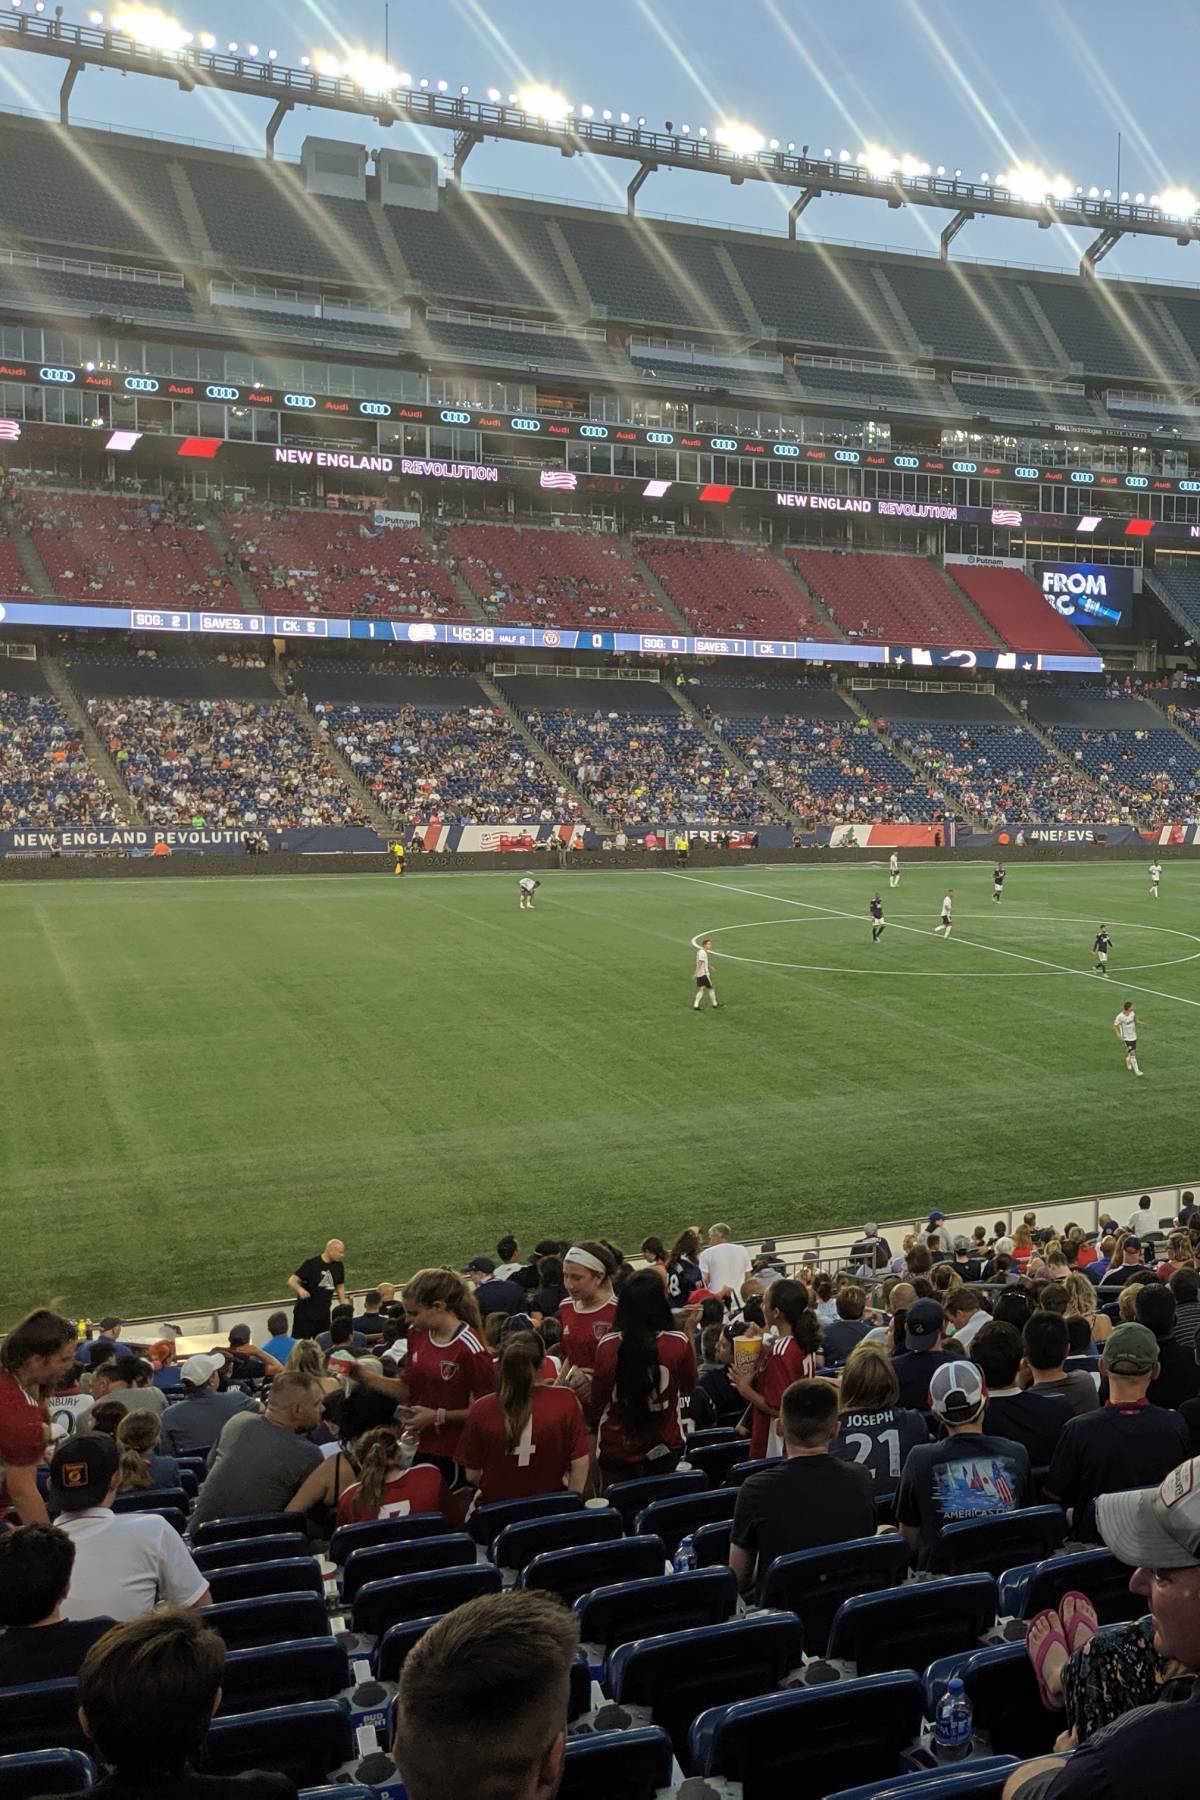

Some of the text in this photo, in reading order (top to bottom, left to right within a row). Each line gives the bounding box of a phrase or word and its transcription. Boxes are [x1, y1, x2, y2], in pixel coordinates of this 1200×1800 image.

[85, 376, 112, 386] Audi
[168, 385, 194, 395] Audi
[248, 393, 273, 403] Audi
[325, 401, 349, 411] Audi
[400, 408, 422, 419] Audi
[479, 417, 501, 427] Audi
[548, 425, 570, 434] Audi
[616, 431, 636, 440] Audi
[681, 438, 701, 447] Audi
[744, 443, 765, 453] Audi
[806, 450, 825, 459] Audi
[866, 455, 885, 464] Audi
[275, 448, 498, 481] NEW ENGLAND REVOLUTION
[926, 461, 944, 470] Audi
[983, 466, 1001, 475] Audi
[1045, 472, 1063, 480] Audi
[1100, 477, 1118, 485] Audi
[1154, 481, 1171, 489] Audi
[776, 493, 957, 520] NEW ENGLAND REVOLUTION
[976, 557, 1004, 565] Putnam
[1042, 572, 1107, 595] FROM
[137, 614, 181, 627] SOG: 2
[203, 618, 259, 630] SAVES: 0
[282, 620, 316, 633] CK: 5
[452, 628, 526, 644] 46:38 HALF 2
[592, 634, 602, 648] 0
[643, 639, 679, 649] SOG: 0
[697, 641, 729, 652] SAVES:
[760, 644, 775, 654] CK:
[13, 833, 55, 847] NEW
[62, 832, 147, 846] ENGLAND
[846, 1410, 894, 1428] JOSEPH
[845, 1428, 901, 1480] 21
[363, 1712, 384, 1722] BUD
